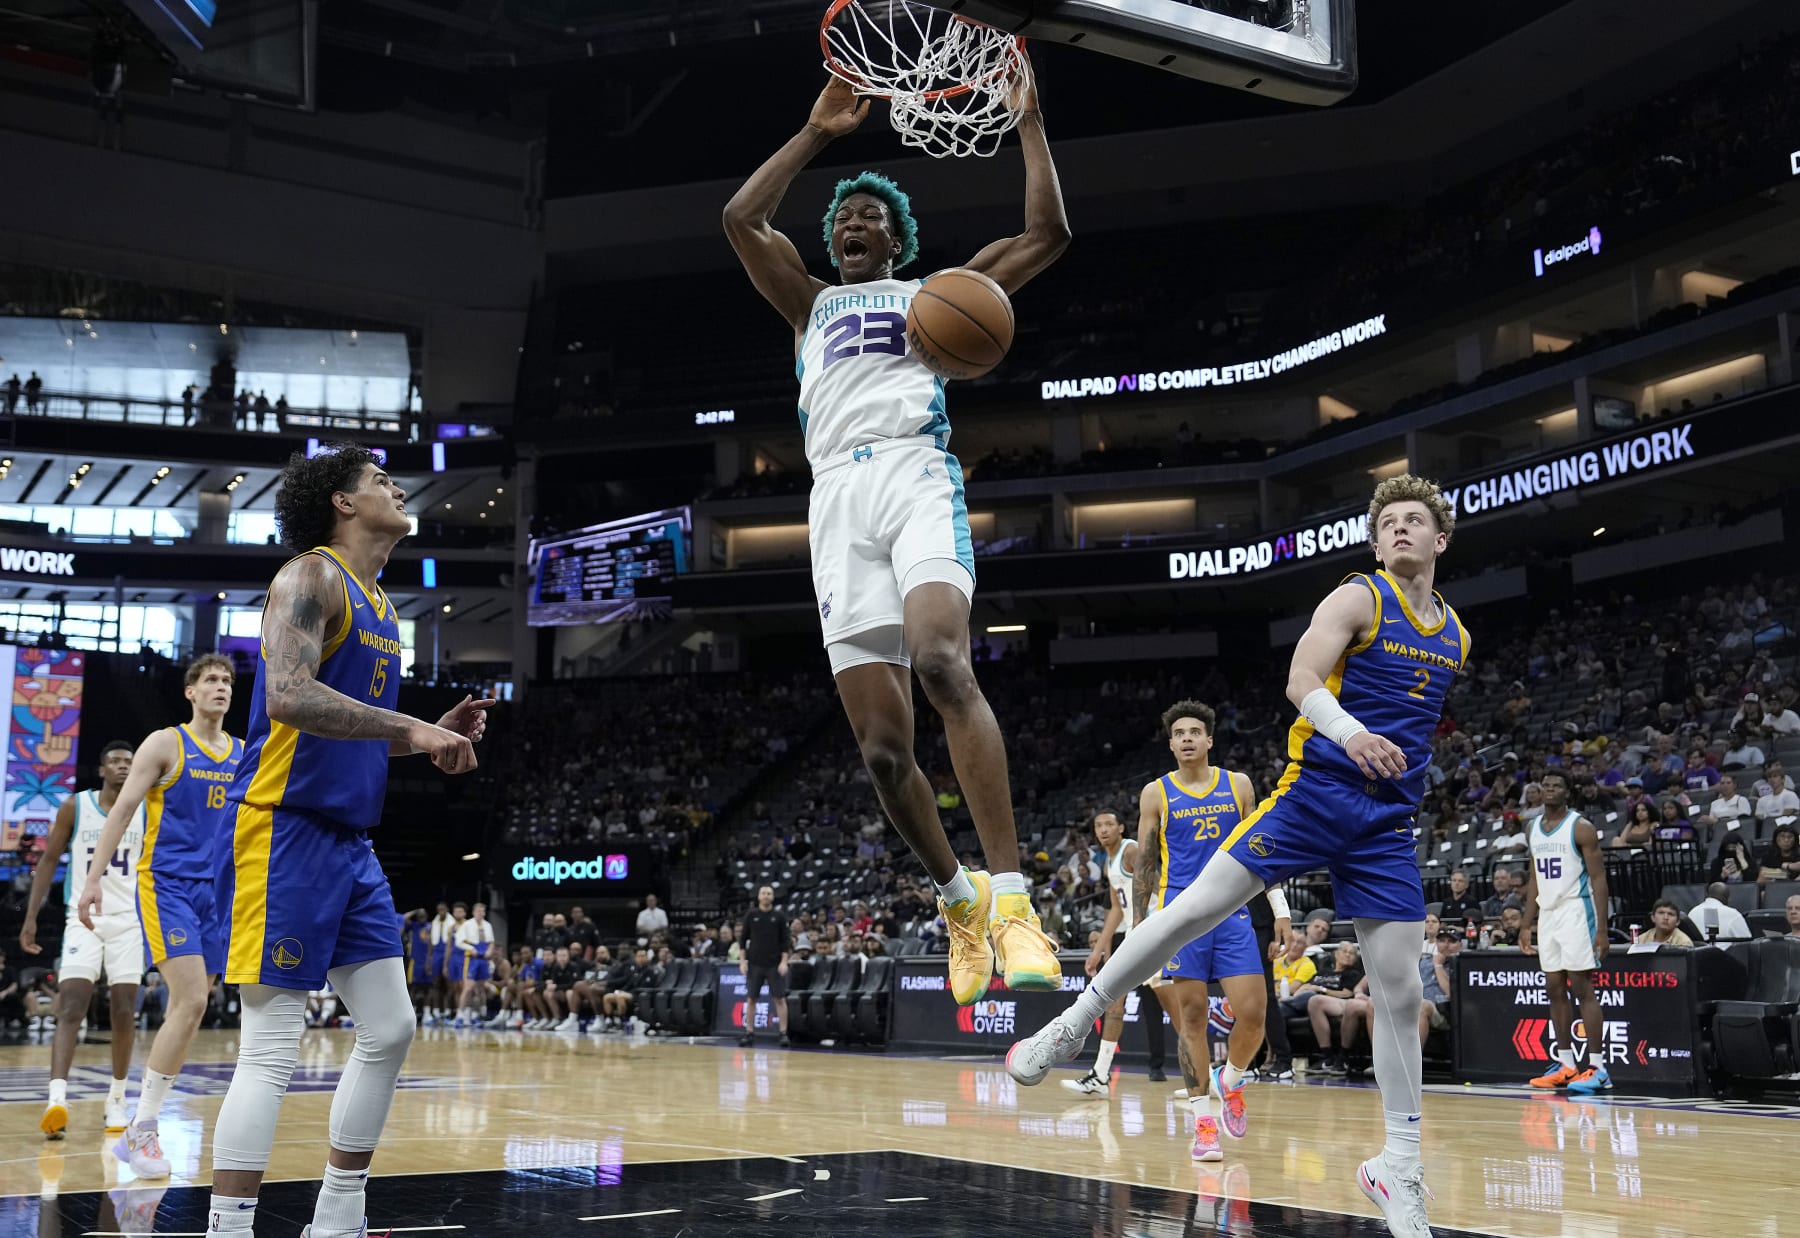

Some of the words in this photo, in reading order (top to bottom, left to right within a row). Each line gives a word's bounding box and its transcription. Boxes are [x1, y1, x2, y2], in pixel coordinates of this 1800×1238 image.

[1544, 235, 1589, 265] dialpad
[815, 294, 914, 330] CHARLOTT
[823, 312, 907, 371] 23
[1042, 377, 1116, 399] DIALPAD
[1139, 373, 1157, 392] IS
[1158, 358, 1272, 390] COMPLETELY
[1271, 332, 1342, 374] CHANGING
[1341, 314, 1386, 348] WORK
[1169, 541, 1272, 578] DIALPAD
[1297, 532, 1316, 558] IS
[1463, 451, 1600, 514] CHANGING
[1602, 423, 1694, 477] WORK
[0, 547, 75, 576] WORK
[1382, 638, 1460, 672] WARRIORS
[368, 657, 389, 698] 15
[1407, 668, 1431, 700] 2
[189, 767, 235, 783] WARRIO
[206, 785, 226, 809] 18
[1171, 803, 1236, 819] WARRIORS
[1192, 816, 1221, 841] 25
[512, 855, 602, 885] dialpad
[1536, 857, 1561, 879] 46
[901, 976, 944, 991] FLASHING
[1469, 971, 1547, 987] FLASHING
[1615, 972, 1679, 988] LIGHTS
[974, 1000, 1016, 1017] MOVE
[974, 1018, 1015, 1034] OVER
